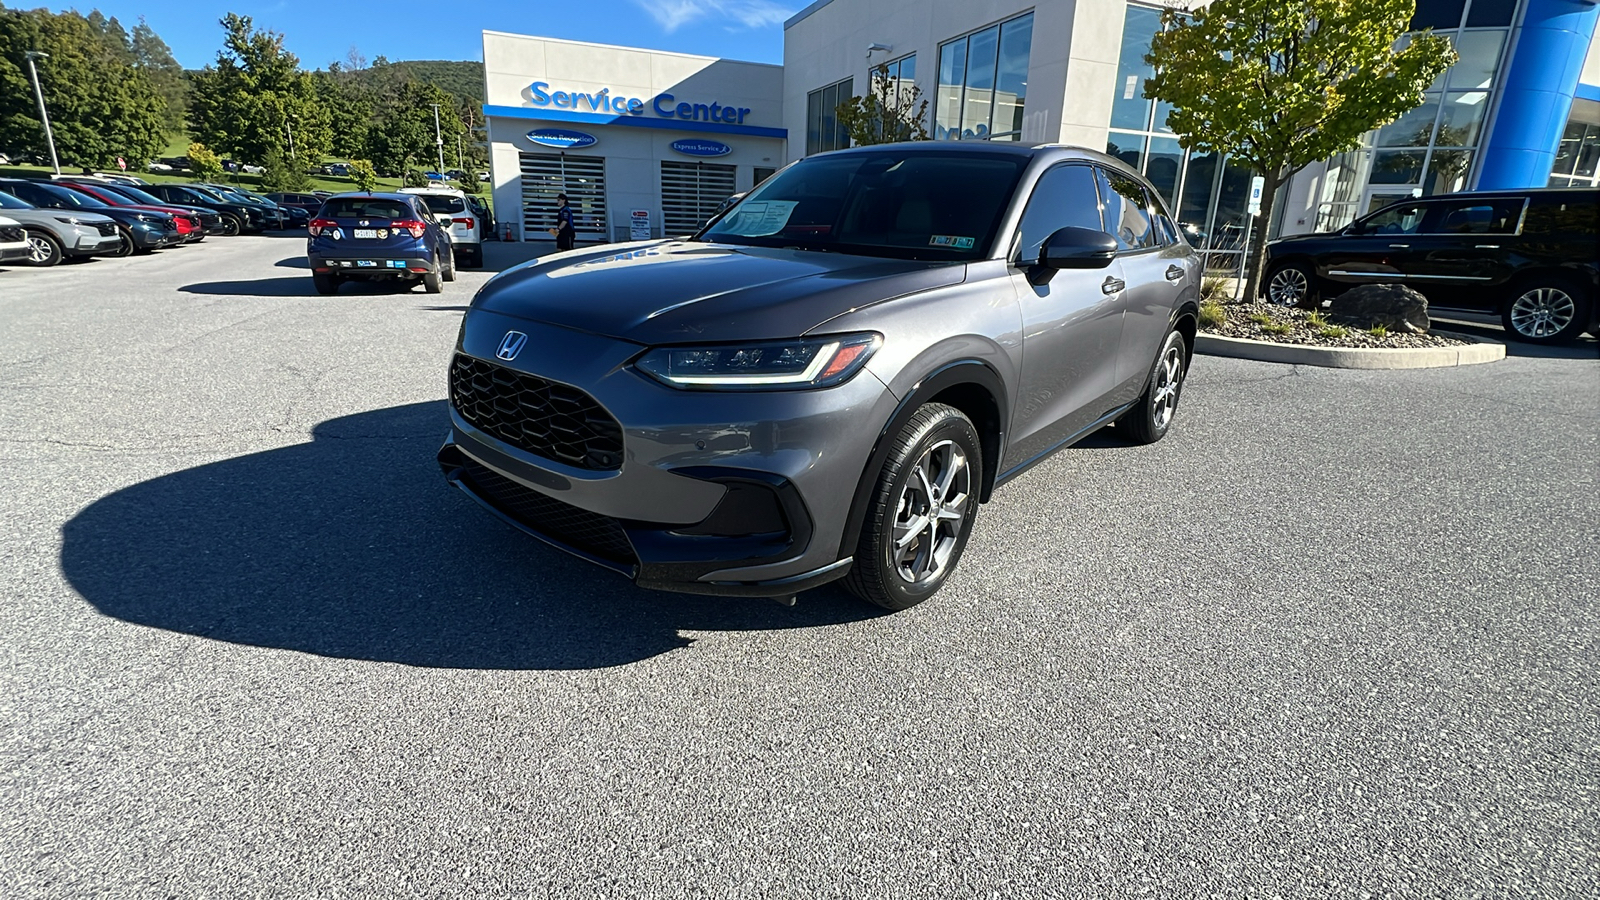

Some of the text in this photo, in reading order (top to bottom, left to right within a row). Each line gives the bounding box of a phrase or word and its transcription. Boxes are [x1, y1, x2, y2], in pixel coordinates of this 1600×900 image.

[530, 81, 750, 124] Service Center
[531, 132, 593, 143] Service Reception
[673, 142, 719, 152] Express Service
